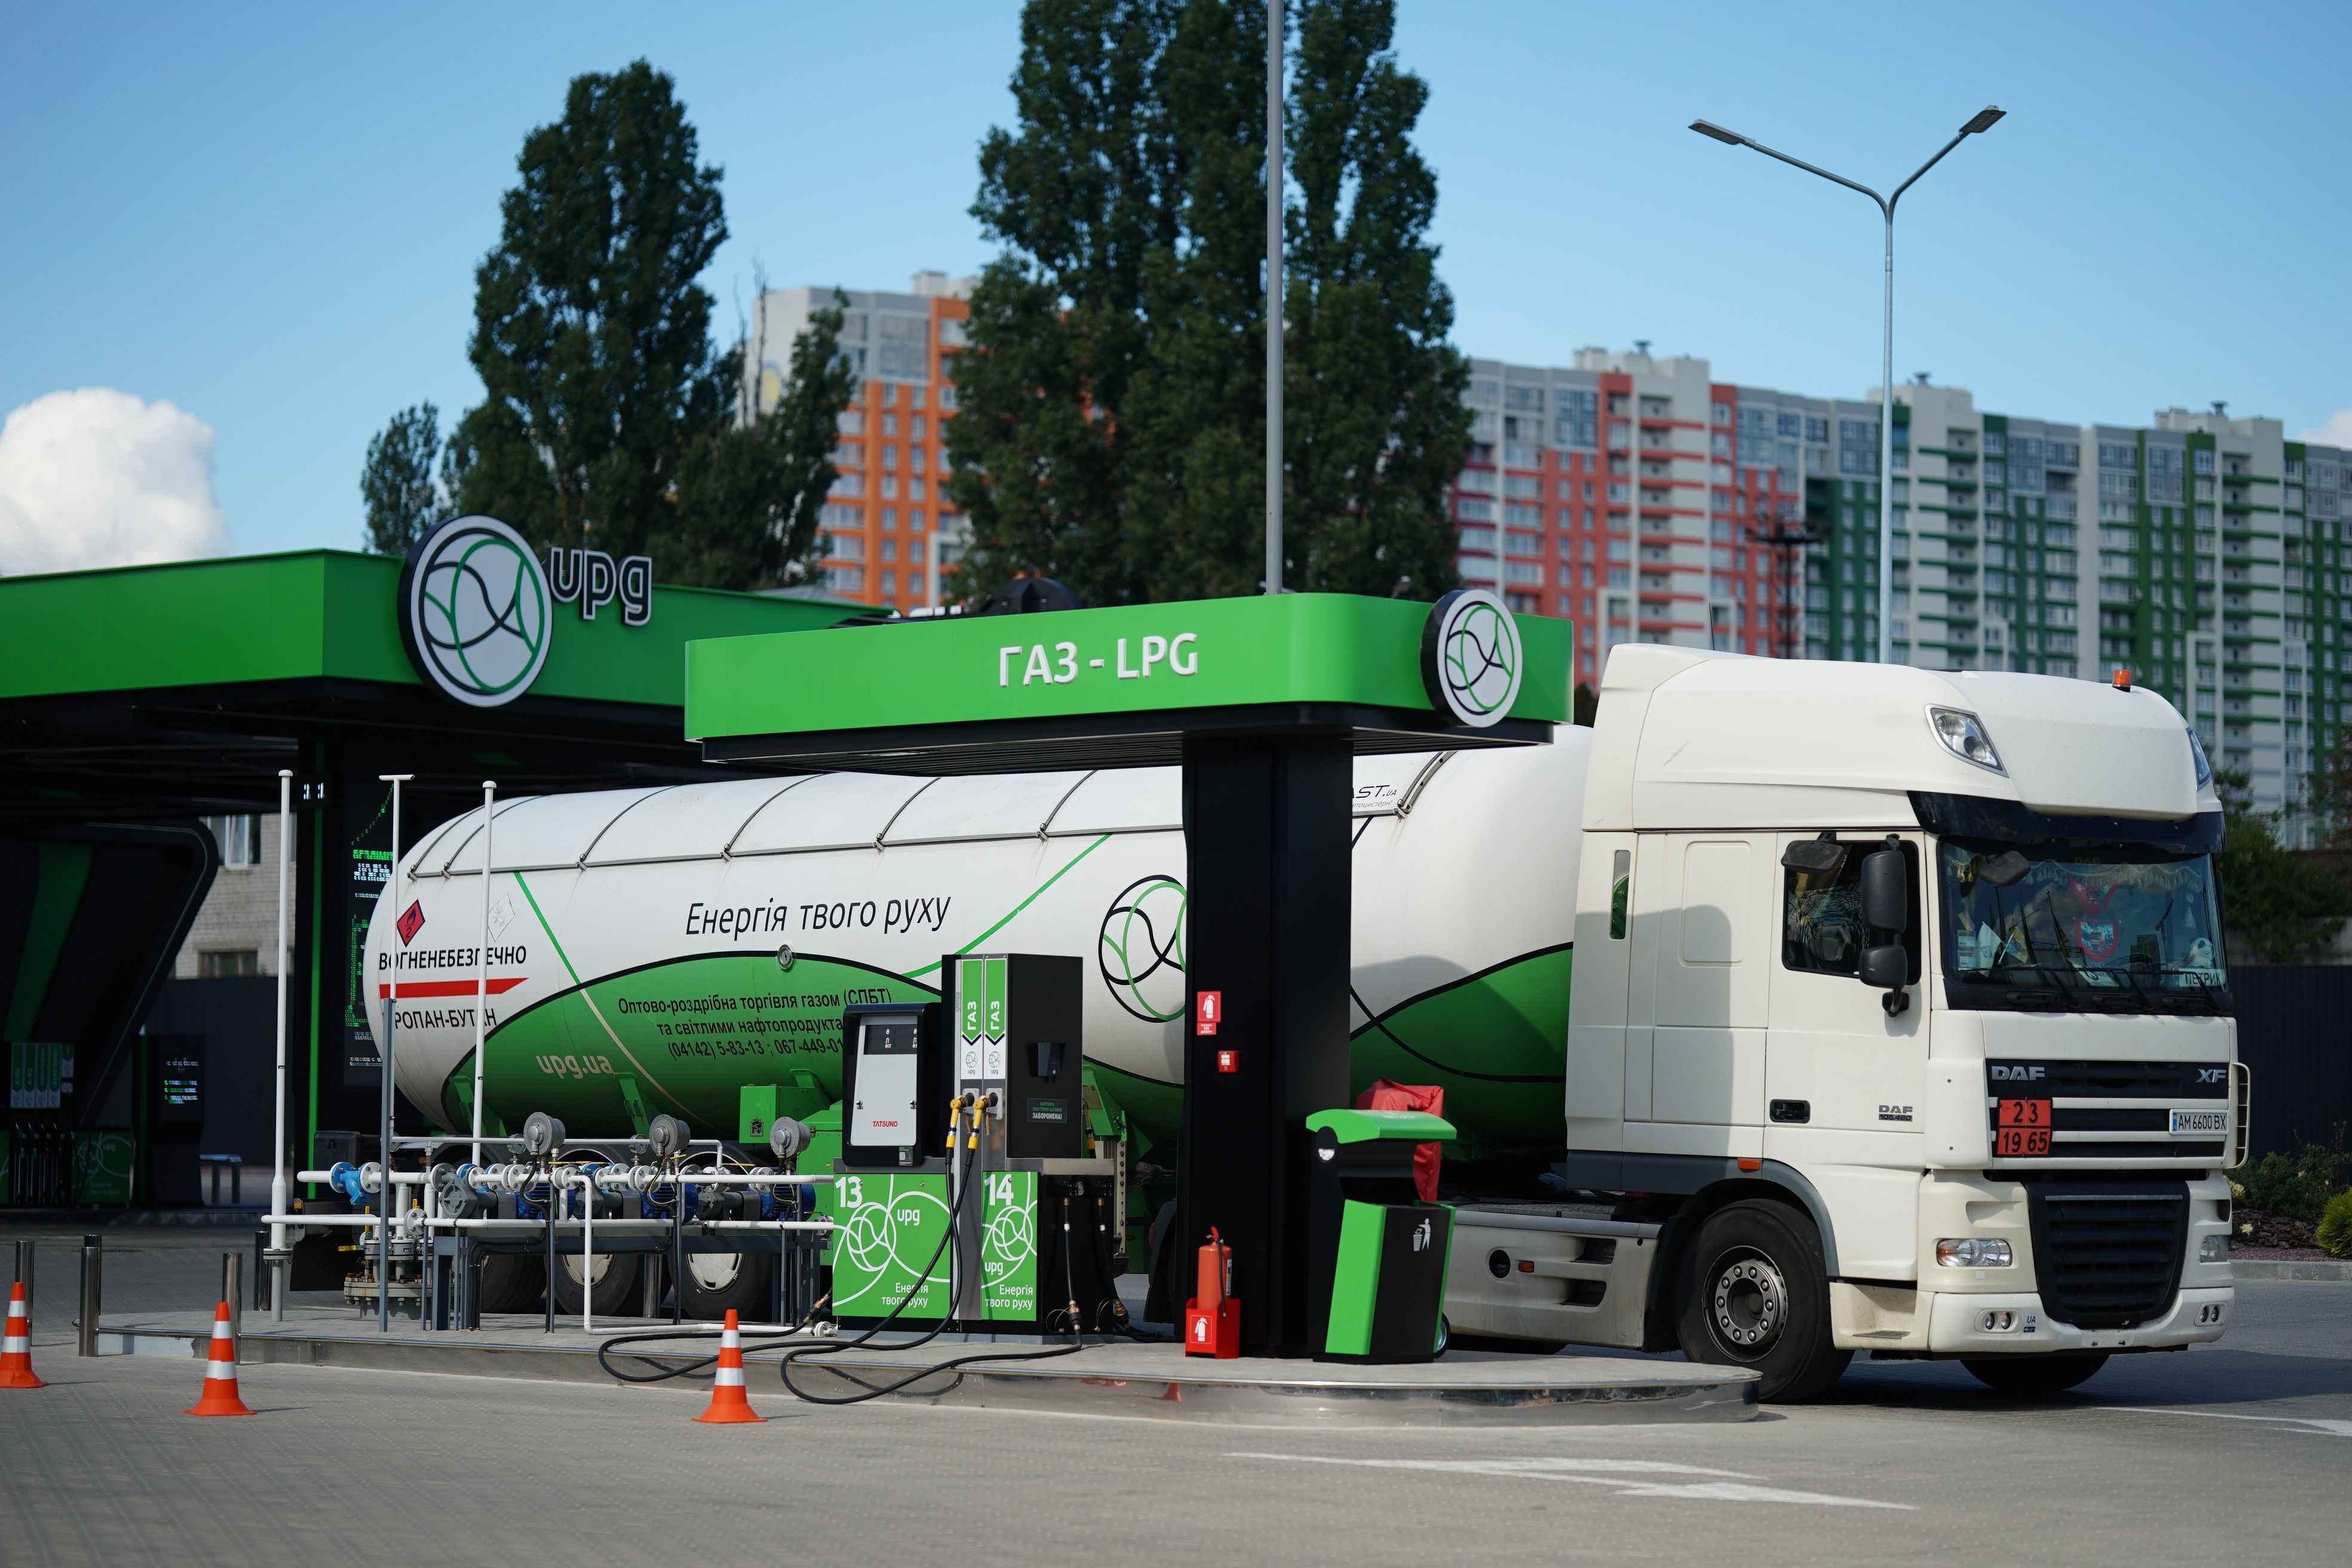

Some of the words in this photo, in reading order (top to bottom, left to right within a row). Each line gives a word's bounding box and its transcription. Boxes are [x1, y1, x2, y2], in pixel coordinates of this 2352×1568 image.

[549, 546, 652, 626] upg
[999, 641, 1079, 688] ГАЗ
[1117, 632, 1198, 679] LPG
[686, 898, 787, 941] Енергія
[800, 901, 876, 930] твого
[884, 896, 951, 934] руху
[618, 994, 737, 1016] Оптово-роздрібна
[739, 993, 798, 1013] торгівля
[801, 994, 841, 1008] газом
[843, 988, 892, 1006] (СПБТ)
[382, 1008, 497, 1030] РОПАН-БУТН
[967, 1000, 977, 1030] ГАЗ
[990, 1000, 1000, 1030] ГАЗ
[657, 1024, 673, 1036] та
[675, 1019, 736, 1035] світлими
[667, 1041, 716, 1061] (04142)
[716, 1040, 765, 1056] 5-83-13
[535, 1055, 614, 1079] upg.ua
[1991, 1065, 2045, 1081] DAF
[2195, 1068, 2227, 1083] XF
[1879, 1105, 1913, 1114] DAF
[2178, 1115, 2191, 1129] AM
[2192, 1115, 2212, 1129] 6600
[2214, 1115, 2226, 1129] BX
[835, 1176, 862, 1209] 13
[984, 1174, 1014, 1206] 14
[897, 1208, 920, 1226] upg
[985, 1261, 1003, 1276] upg
[895, 1282, 928, 1294] Енеія
[999, 1284, 1033, 1297] Енергія
[881, 1296, 907, 1306] твог
[985, 1298, 1010, 1307] твого
[1012, 1299, 1033, 1310] руху
[2027, 1315, 2036, 1324] UA
